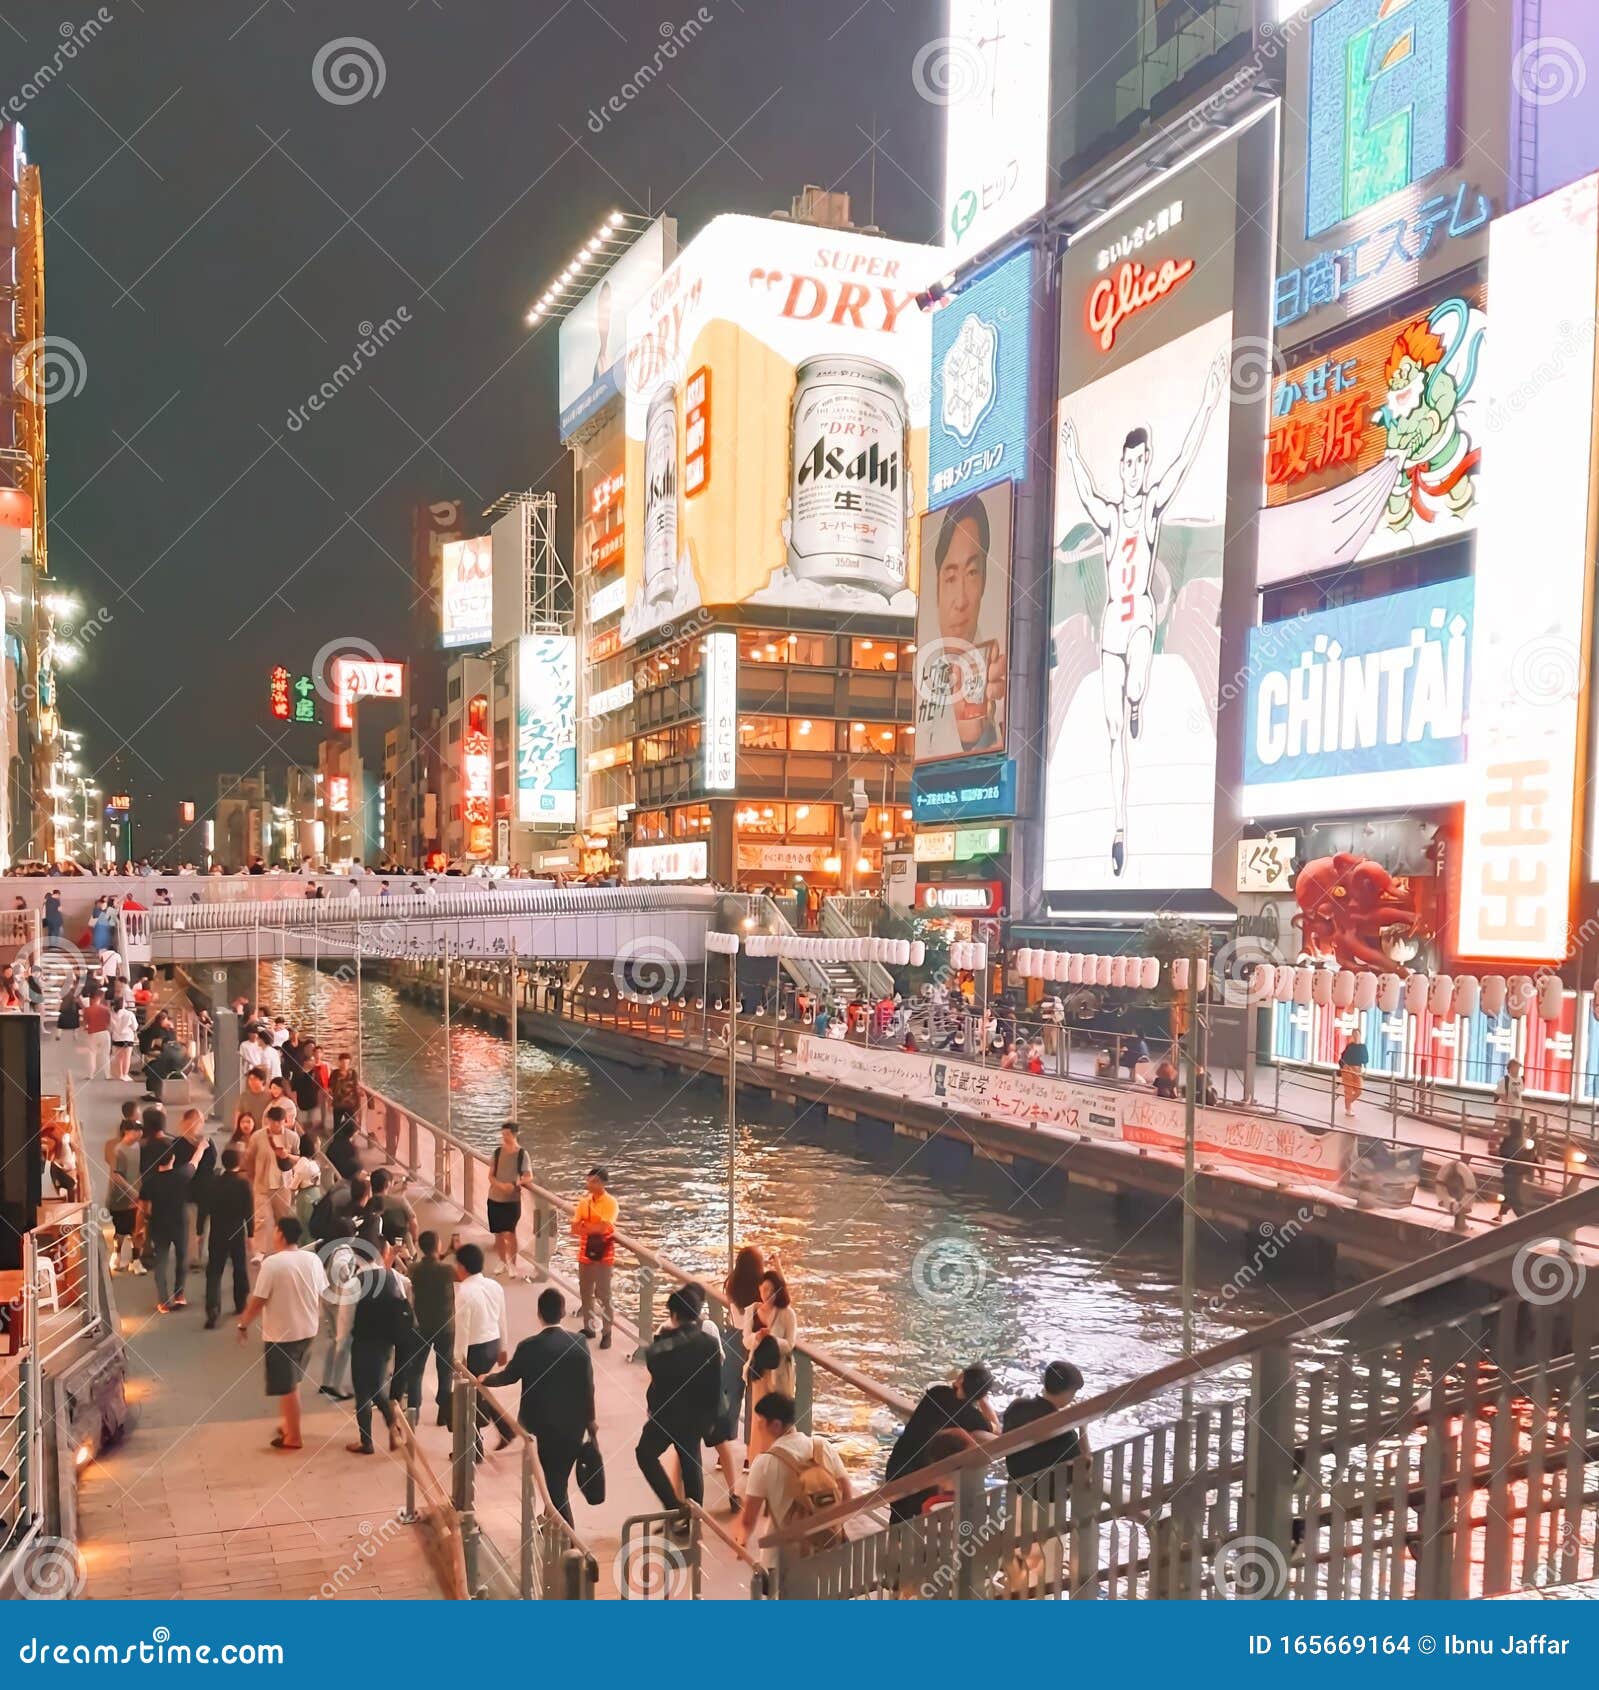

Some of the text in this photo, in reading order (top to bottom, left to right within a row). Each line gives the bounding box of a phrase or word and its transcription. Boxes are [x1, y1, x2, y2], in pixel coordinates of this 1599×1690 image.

[815, 249, 900, 279] SUPER
[1089, 259, 1195, 350] Glico
[1273, 358, 1357, 417] かぜに
[798, 436, 898, 492] Asahi
[1266, 391, 1372, 485] 改源
[820, 521, 878, 536] スーパードライ
[835, 490, 862, 511] 生
[1121, 532, 1139, 622] グリコ
[347, 669, 395, 695] かに
[1256, 608, 1467, 766] CHINTAI
[1478, 758, 1552, 943] 玉出
[938, 888, 987, 907] LOTTERIA
[991, 1094, 1081, 1127] オープンキャンパス
